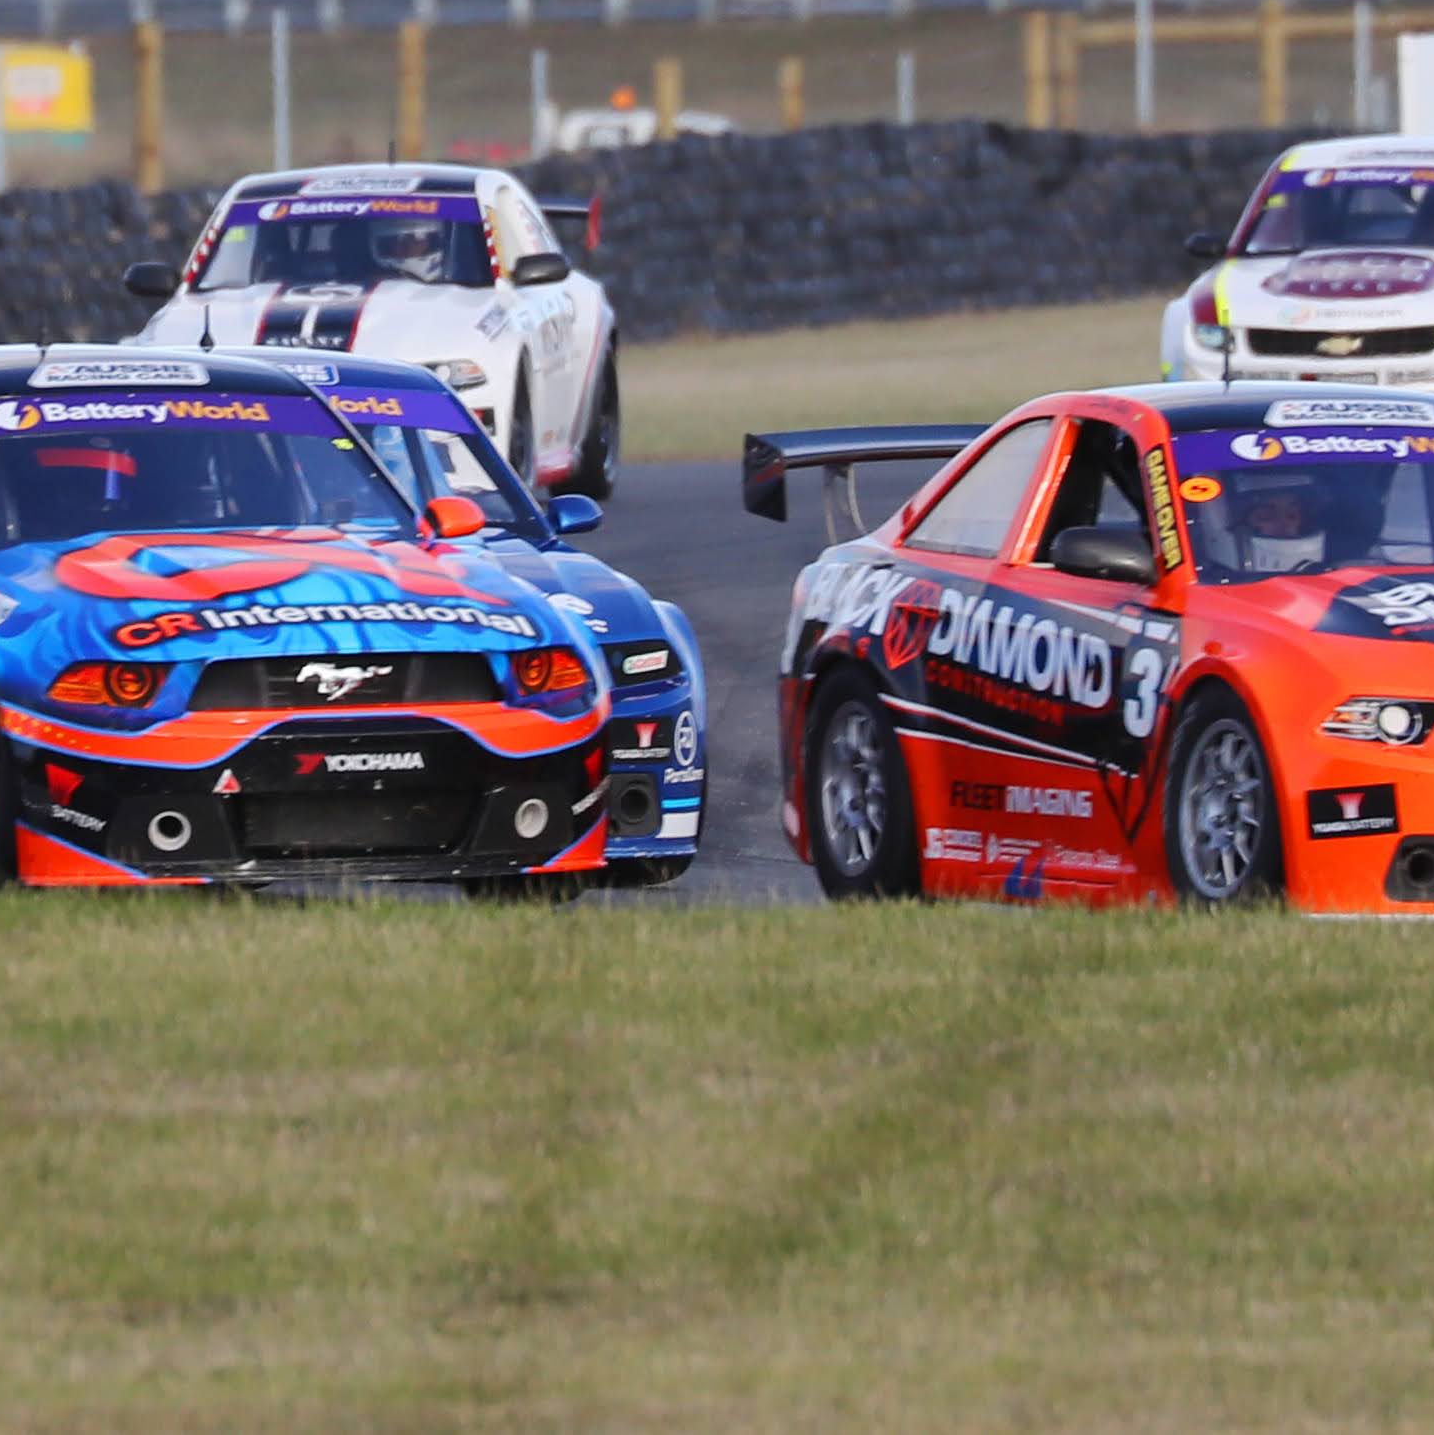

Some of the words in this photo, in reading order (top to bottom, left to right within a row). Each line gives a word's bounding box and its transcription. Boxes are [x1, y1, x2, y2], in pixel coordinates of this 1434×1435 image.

[41, 400, 271, 433] BatteryWorld
[1156, 506, 1182, 569] OVER
[115, 613, 202, 647] CR
[205, 602, 536, 638] International
[927, 587, 1112, 709] DIAMOND
[1123, 649, 1162, 738] 3
[324, 752, 425, 772] YOKOHAMA
